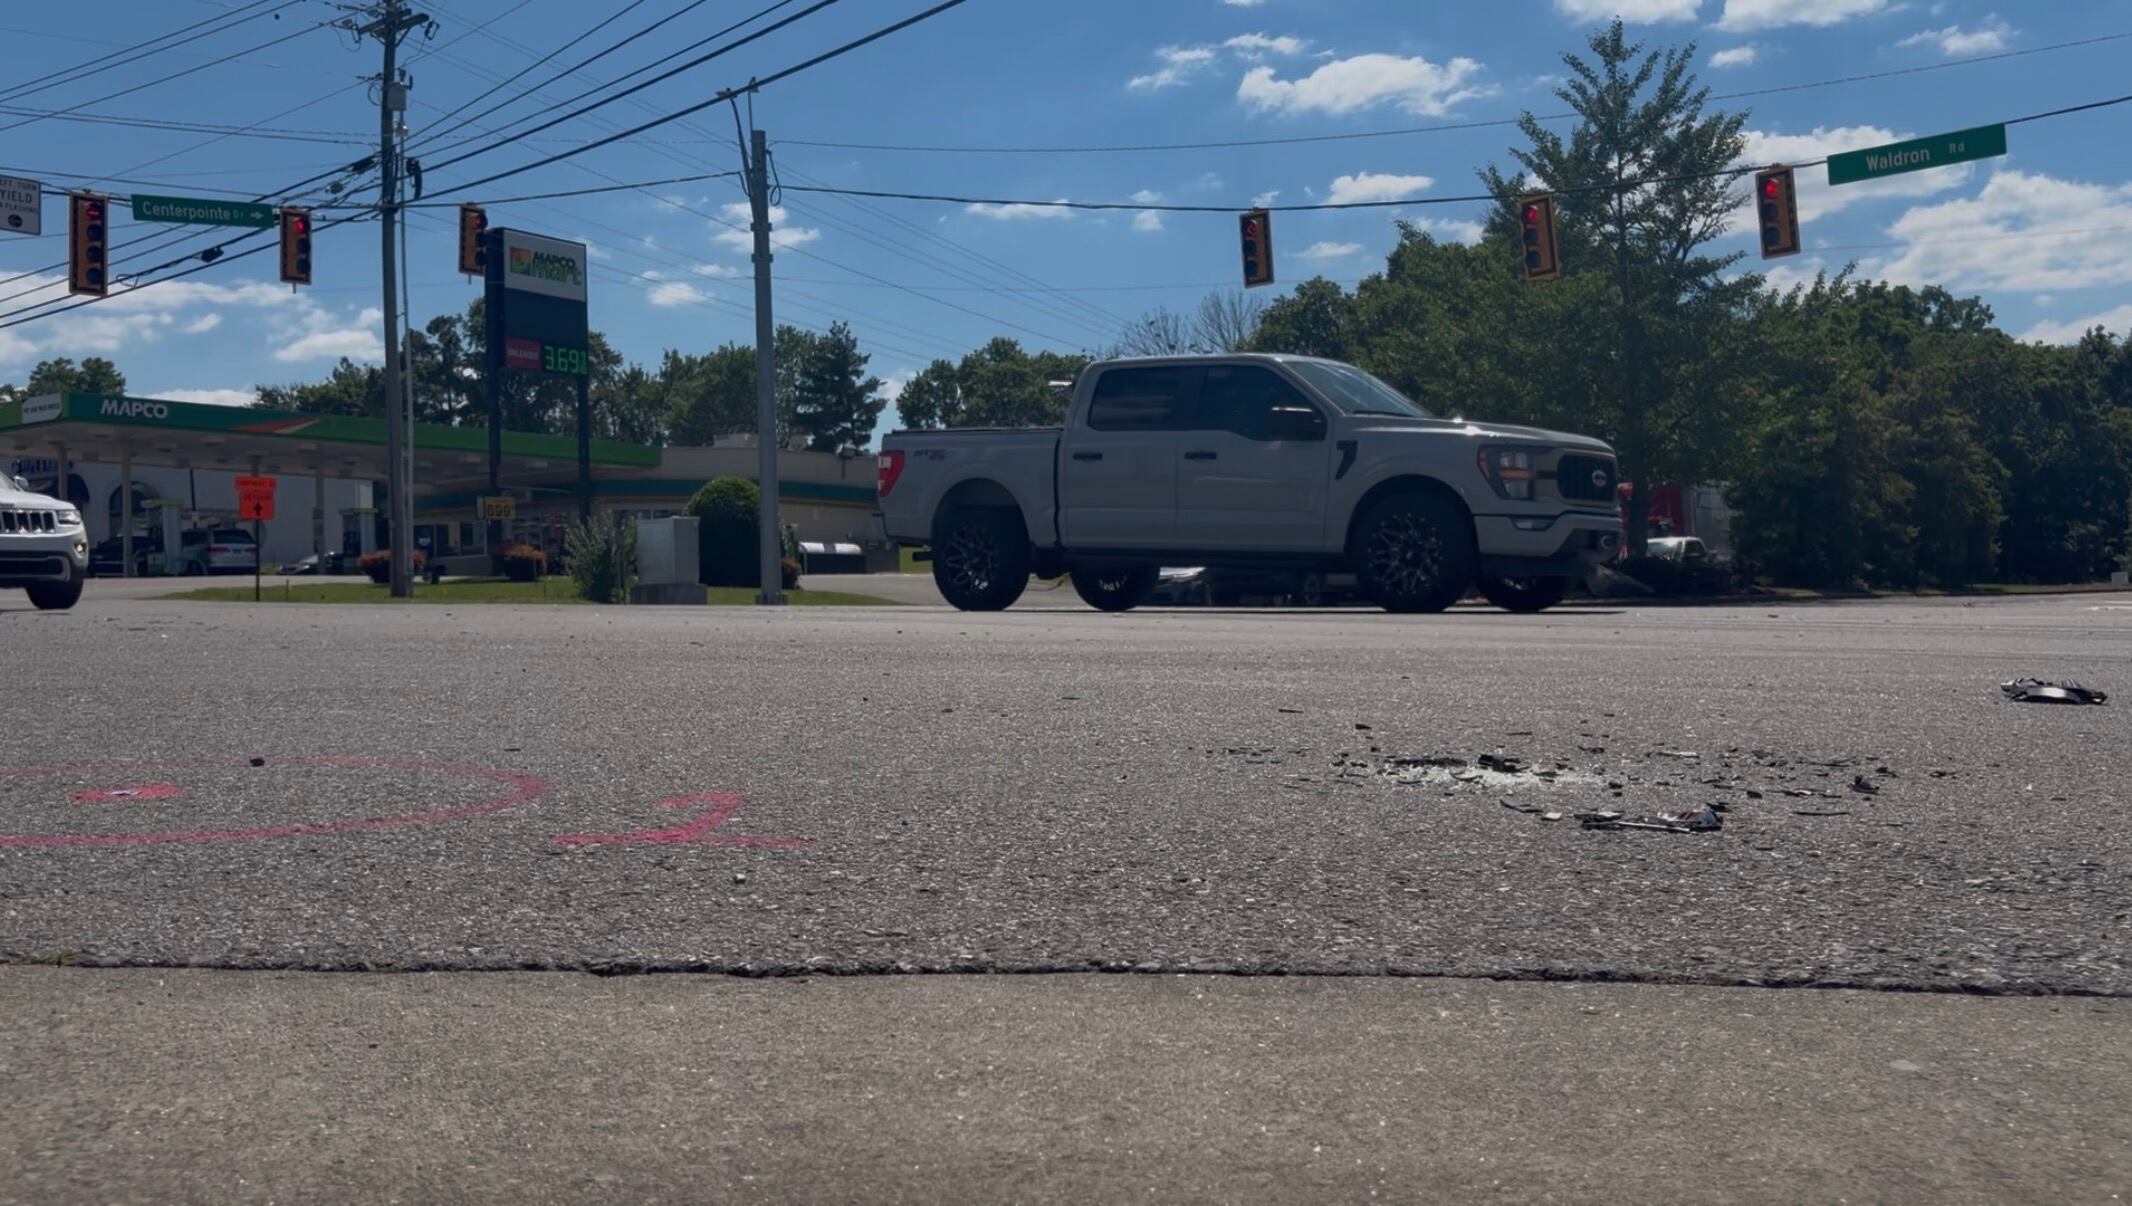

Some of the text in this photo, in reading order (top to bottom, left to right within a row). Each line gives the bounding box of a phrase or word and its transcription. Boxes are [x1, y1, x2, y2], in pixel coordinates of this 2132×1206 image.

[1865, 141, 1966, 172] Waldron Rd
[0, 190, 33, 204] YIELD
[142, 201, 231, 221] Centerpointe
[532, 251, 576, 269] MAPCO
[100, 399, 168, 419] MAPCO
